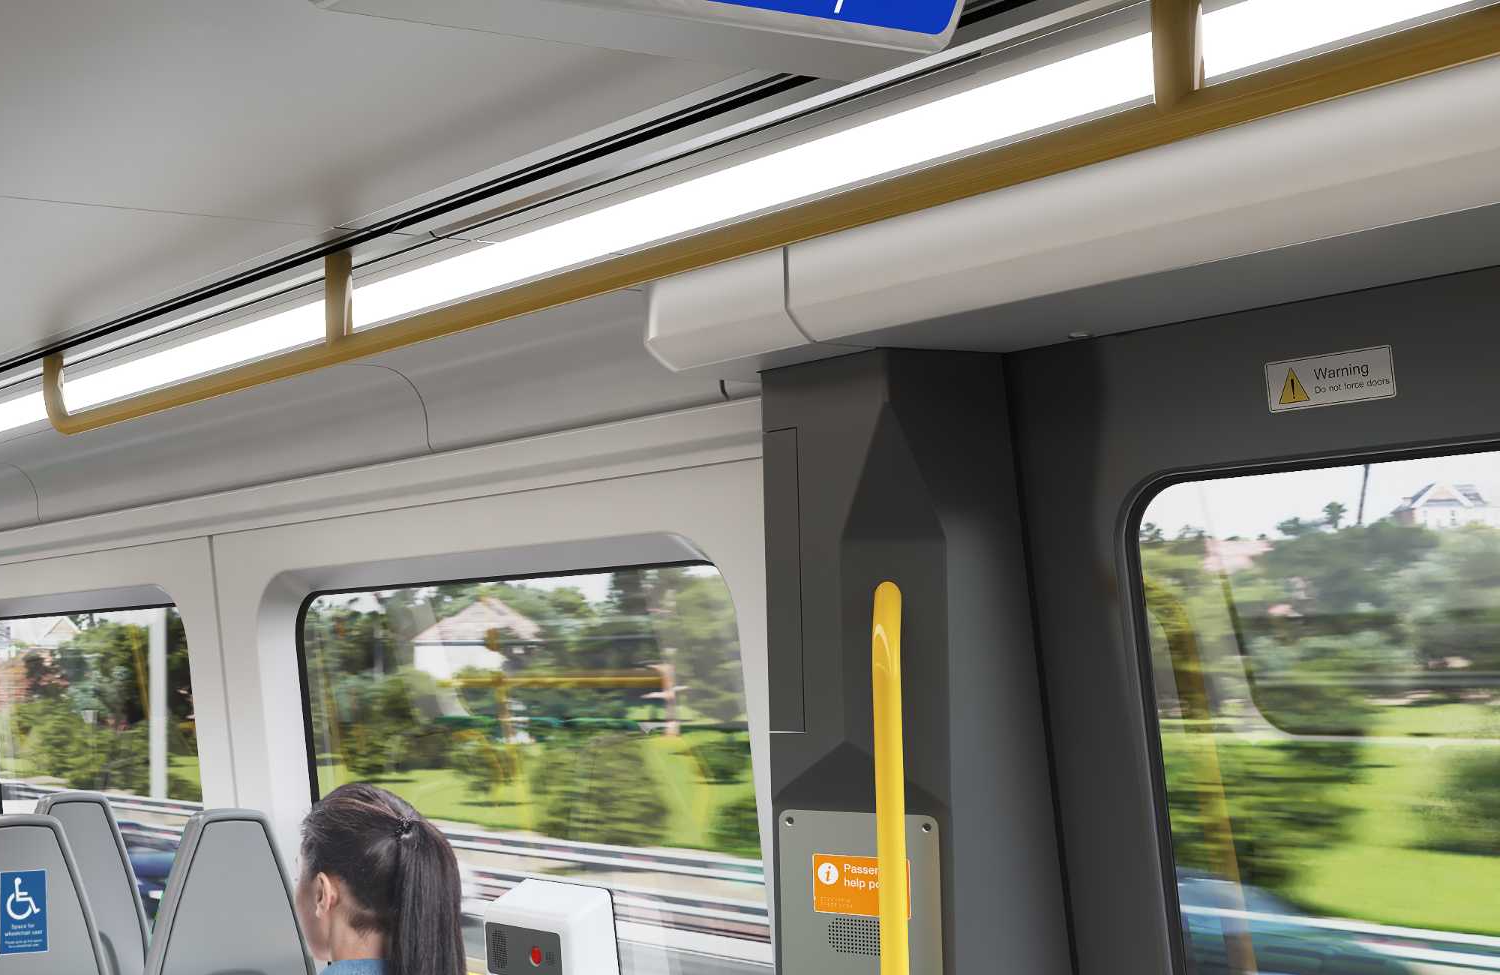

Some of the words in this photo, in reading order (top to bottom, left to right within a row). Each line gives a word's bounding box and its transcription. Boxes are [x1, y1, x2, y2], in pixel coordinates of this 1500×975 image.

[1313, 363, 1370, 380] Warning
[1314, 385, 1327, 394] Do
[1329, 384, 1342, 392] not
[1344, 382, 1365, 390] force
[1366, 378, 1391, 387] doors
[843, 877, 866, 890] help
